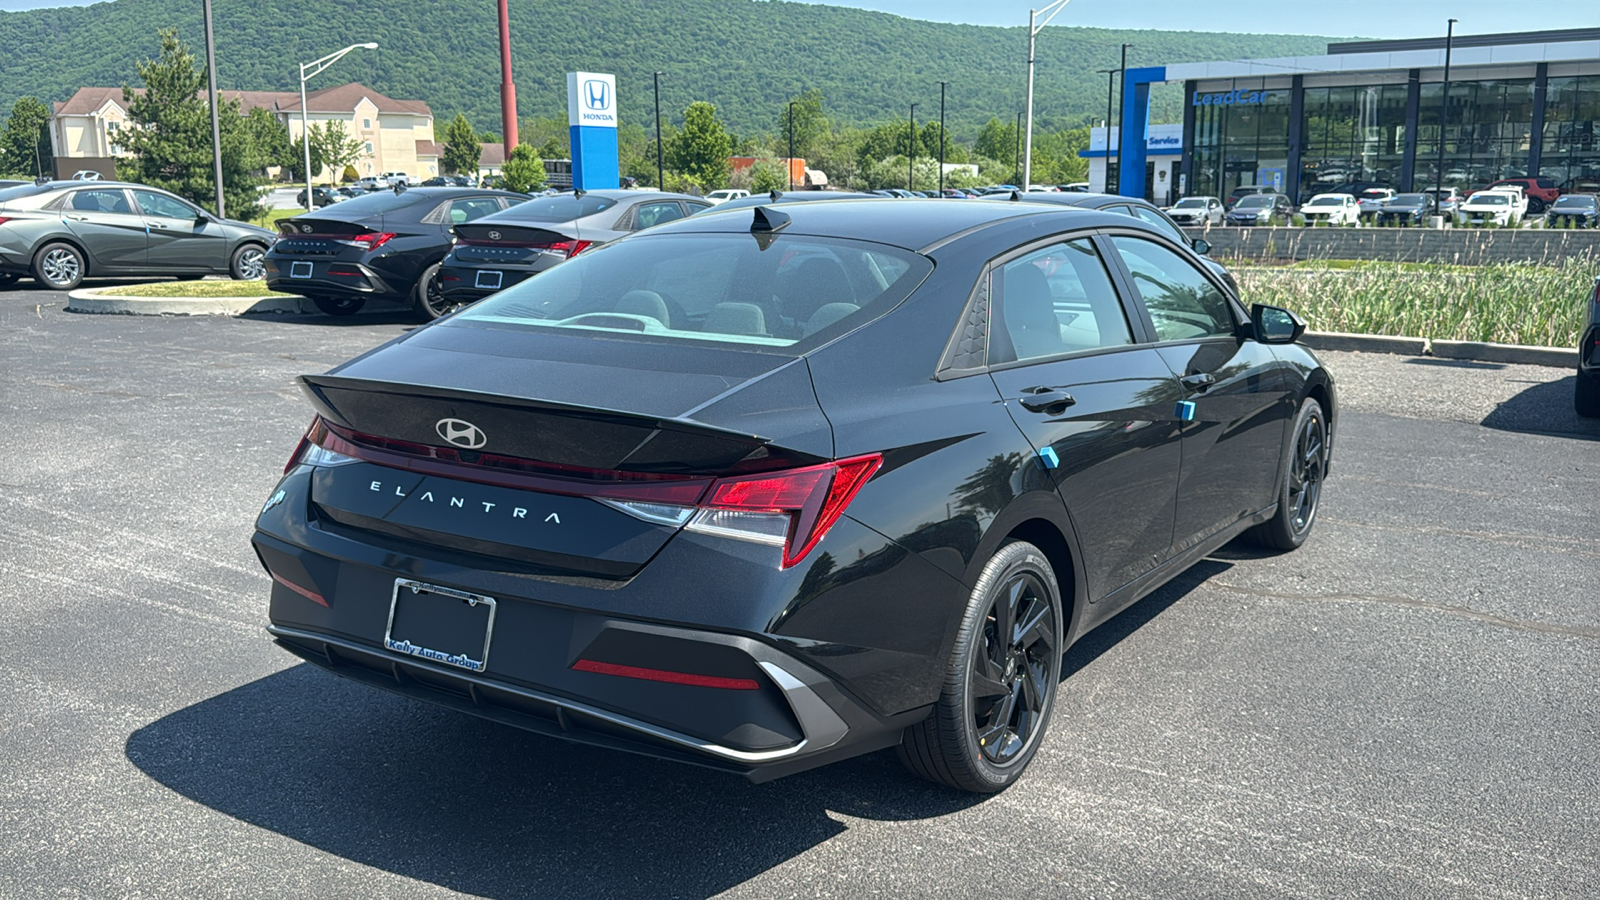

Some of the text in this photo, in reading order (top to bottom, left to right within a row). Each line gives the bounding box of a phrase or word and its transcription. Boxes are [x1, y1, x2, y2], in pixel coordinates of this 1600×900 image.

[1192, 88, 1267, 106] LeadCar
[583, 113, 613, 121] HONDA
[1149, 136, 1179, 145] Service
[370, 480, 561, 524] ELANTRA
[389, 640, 479, 670] Kelly Auto Group
